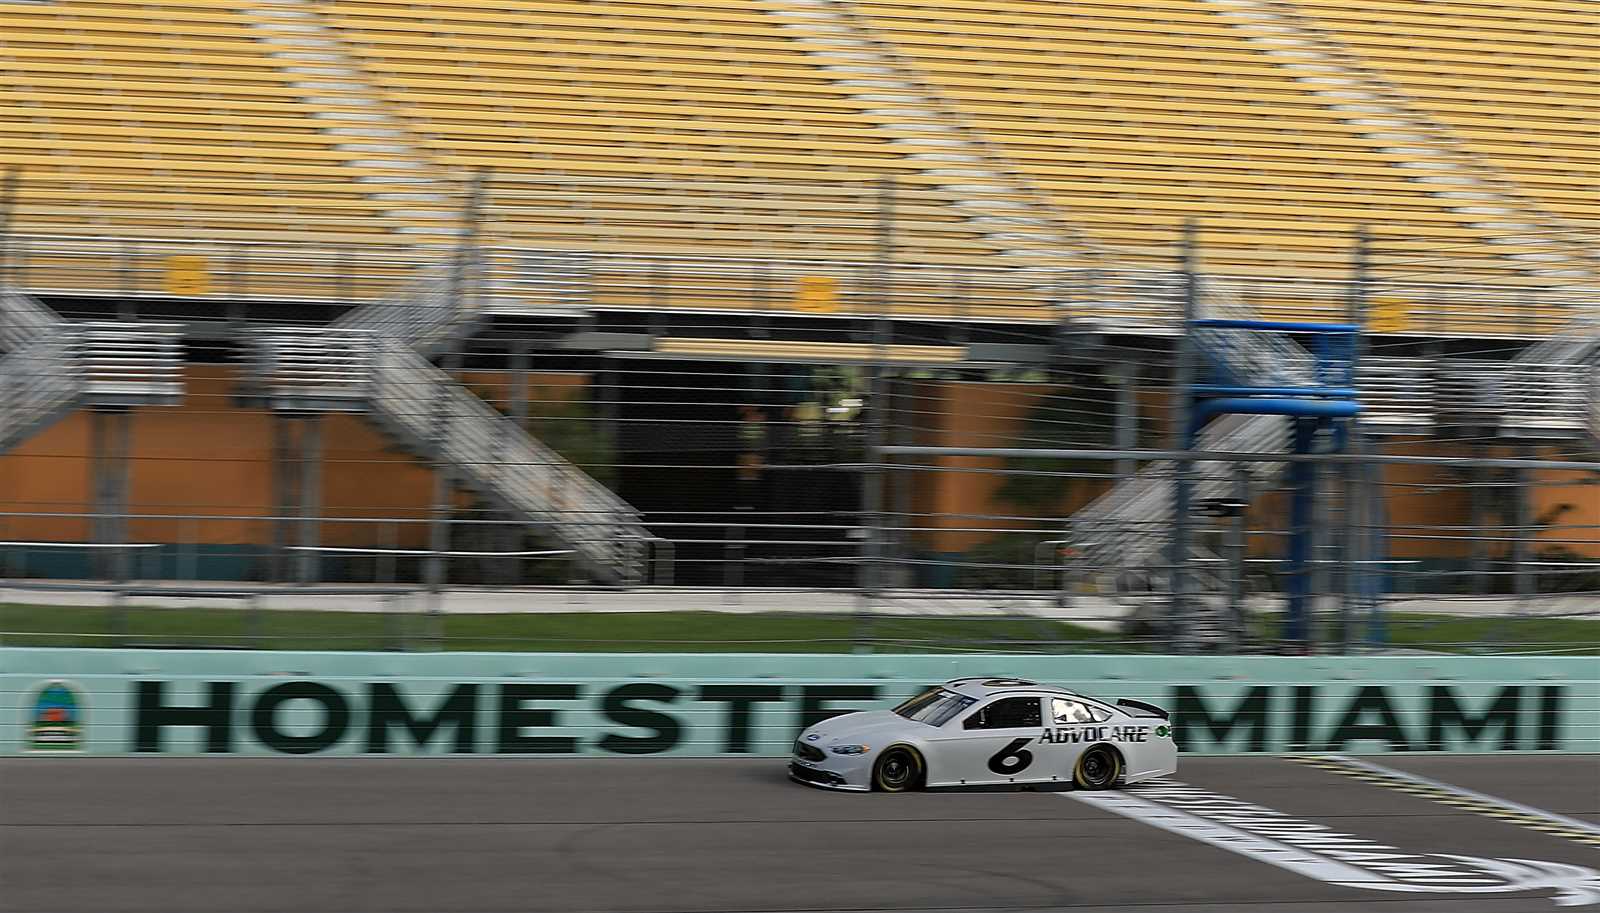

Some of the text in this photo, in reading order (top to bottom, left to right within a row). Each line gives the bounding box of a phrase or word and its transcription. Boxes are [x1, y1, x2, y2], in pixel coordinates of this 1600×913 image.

[131, 681, 1563, 754] HOMESTE MIAMI
[1038, 726, 1149, 744] ADVOCARE
[988, 738, 1035, 775] 6
